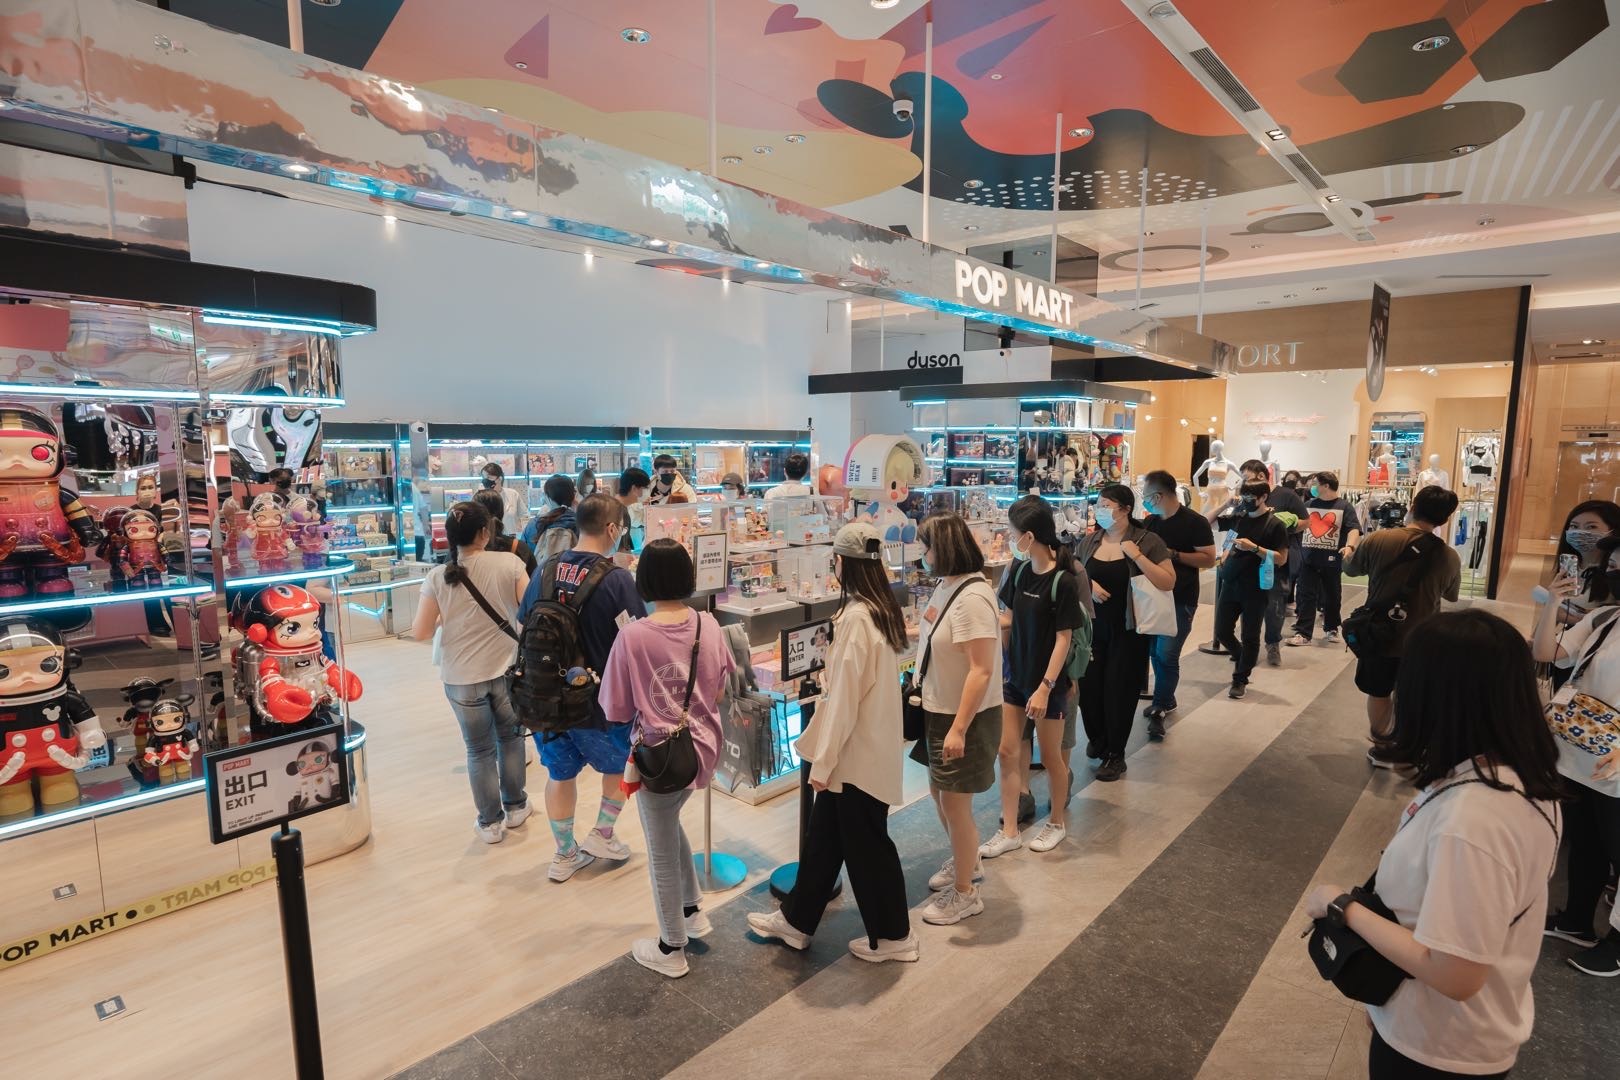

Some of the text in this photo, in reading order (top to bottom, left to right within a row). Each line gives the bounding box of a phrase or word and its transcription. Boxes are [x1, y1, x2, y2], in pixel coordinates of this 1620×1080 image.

[955, 259, 1074, 325] POP MART
[789, 641, 805, 655] 入口
[789, 653, 805, 663] ENTER
[224, 770, 268, 797] 出口
[225, 794, 256, 811] EXIT
[0, 912, 119, 962] OP MART
